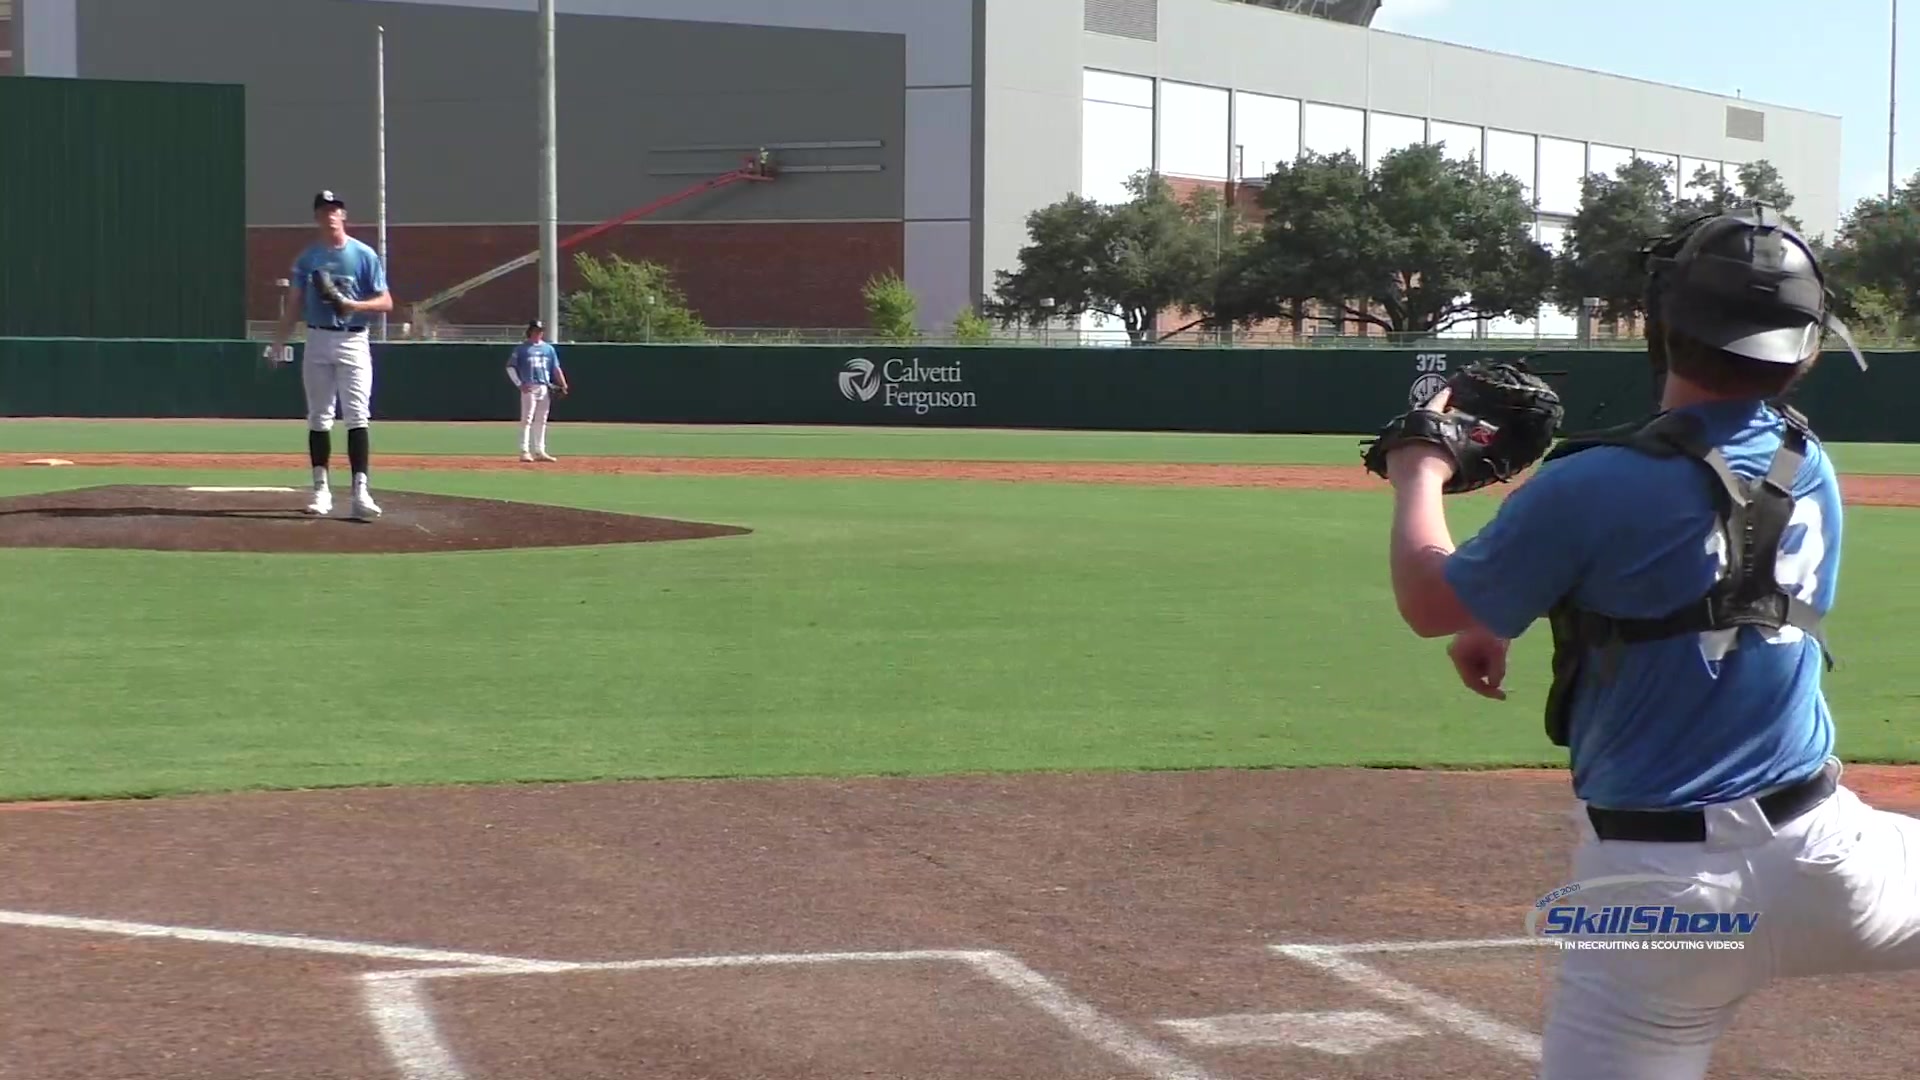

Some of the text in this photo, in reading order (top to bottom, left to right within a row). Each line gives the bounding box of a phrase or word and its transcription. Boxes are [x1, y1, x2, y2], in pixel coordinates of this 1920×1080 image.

[883, 358, 962, 383] Calvetti
[1416, 353, 1447, 372] 375
[884, 383, 977, 415] Ferguson
